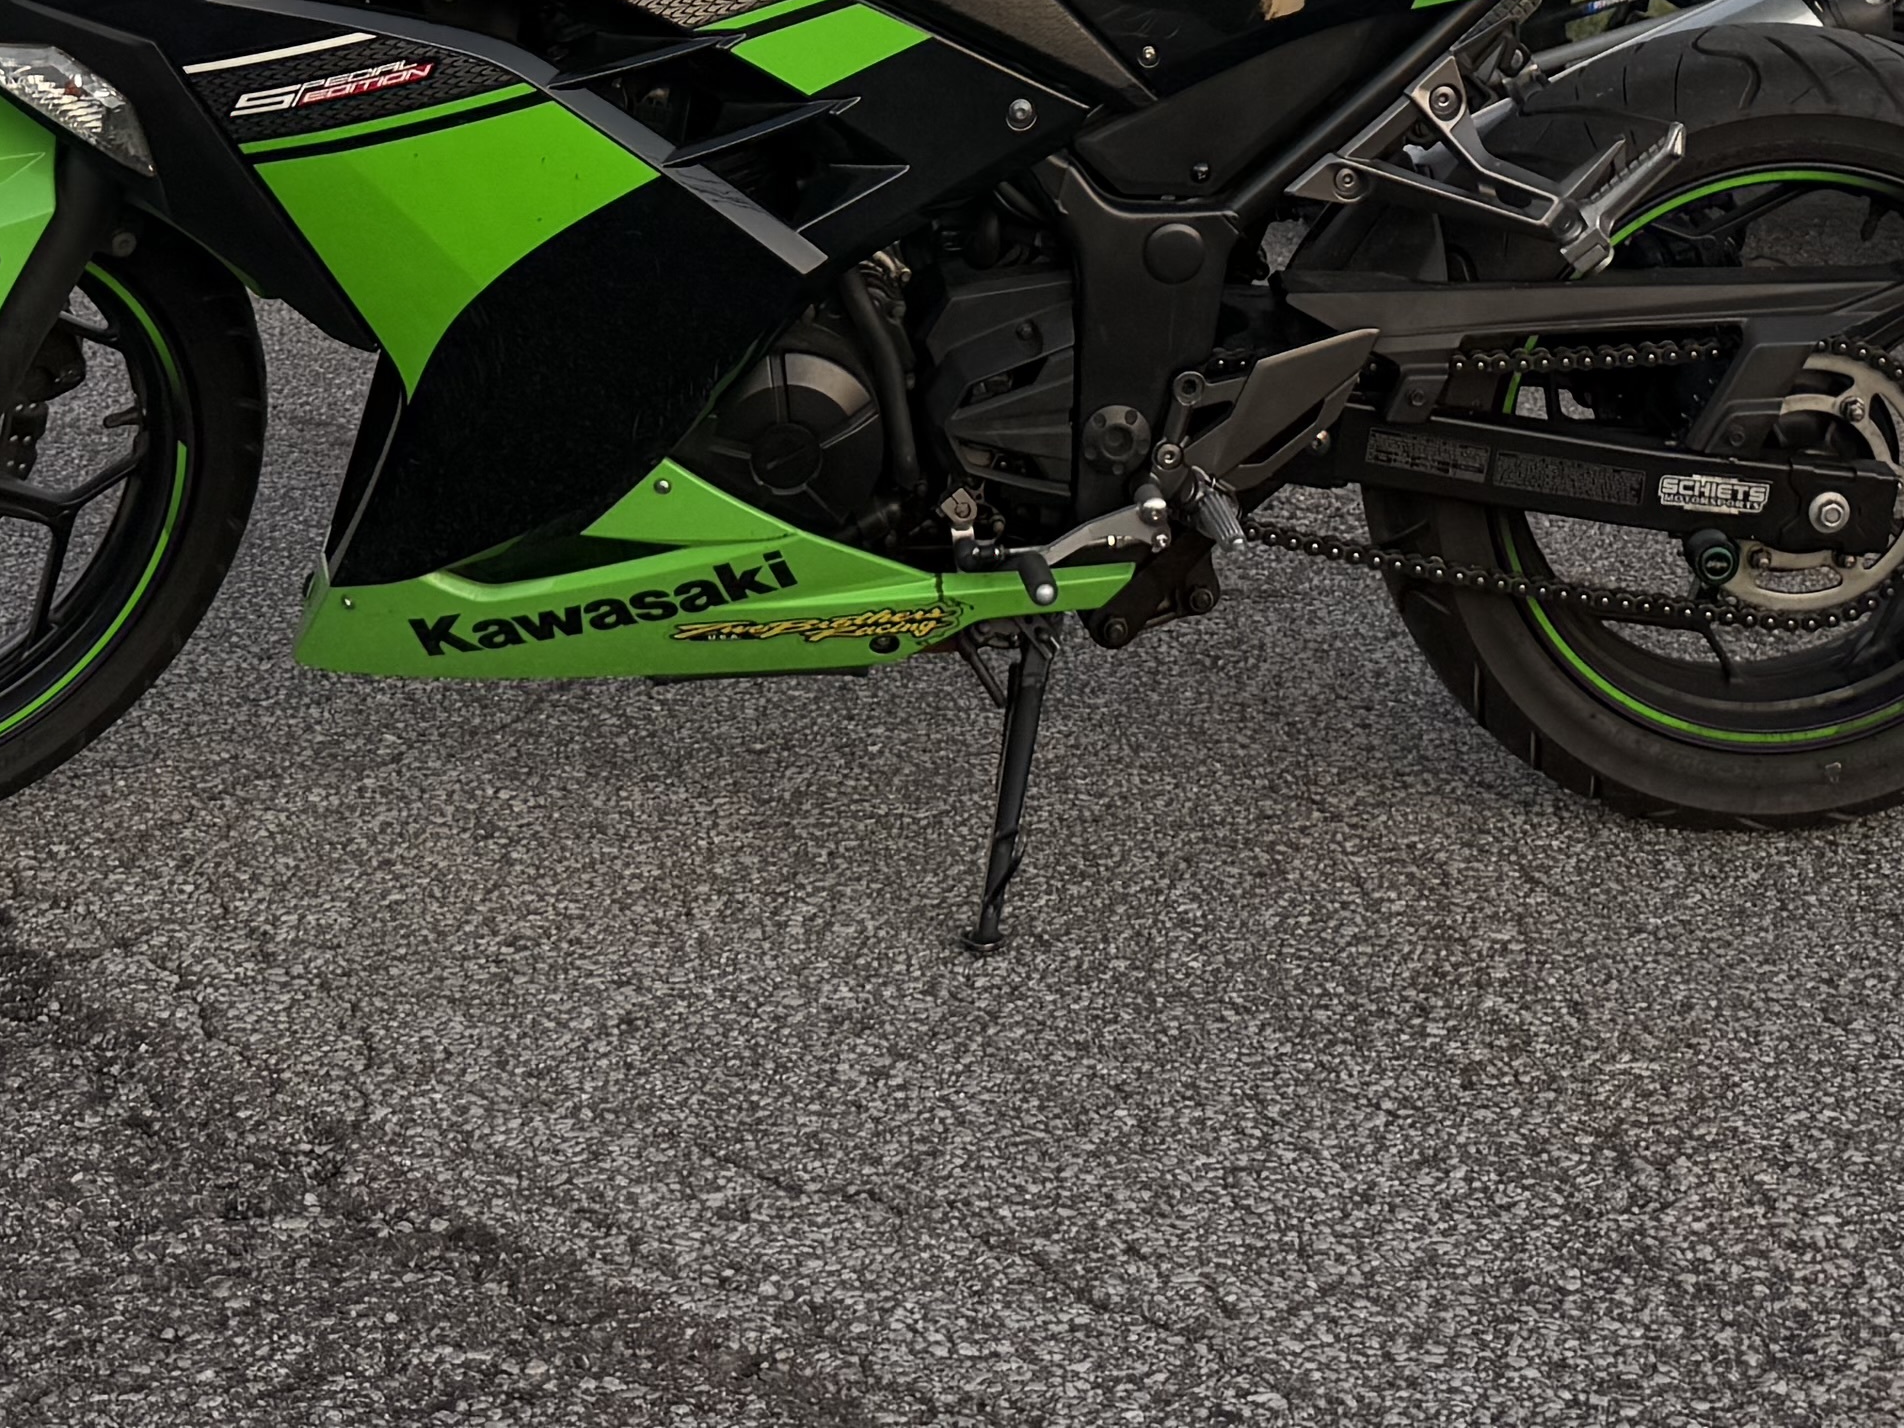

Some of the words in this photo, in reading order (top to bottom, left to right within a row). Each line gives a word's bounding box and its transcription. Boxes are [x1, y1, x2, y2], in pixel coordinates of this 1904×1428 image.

[229, 60, 418, 118] SPECIAL
[299, 63, 436, 105] EDITION
[1661, 477, 1767, 503] SCHIETS
[407, 549, 798, 657] Kawasaki
